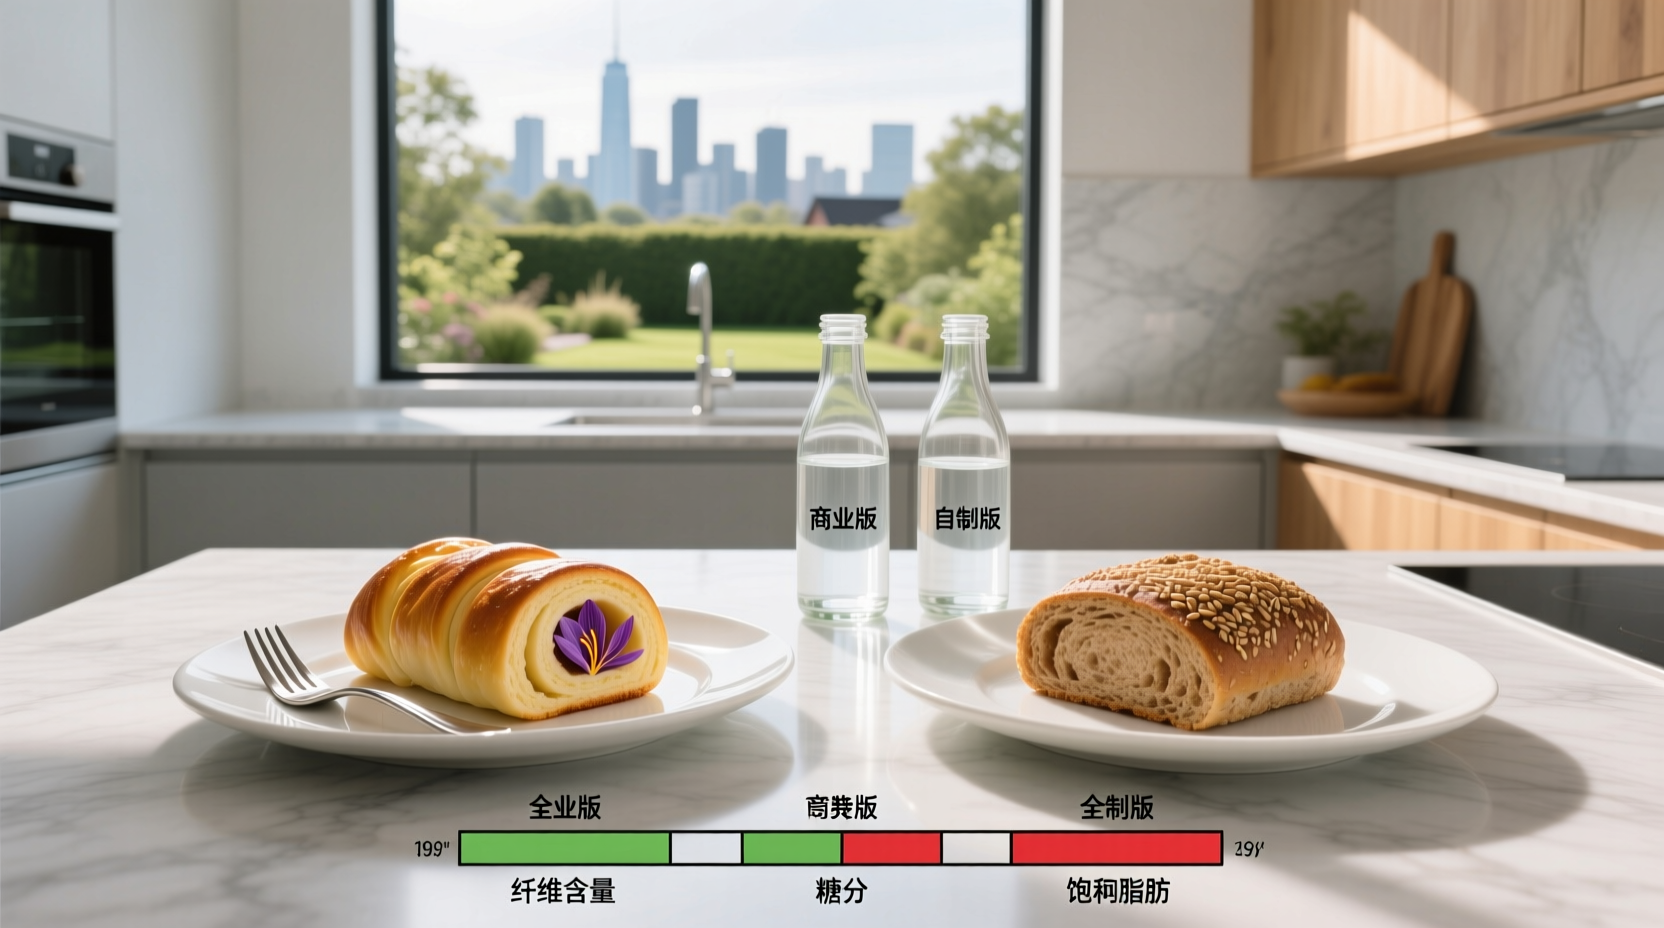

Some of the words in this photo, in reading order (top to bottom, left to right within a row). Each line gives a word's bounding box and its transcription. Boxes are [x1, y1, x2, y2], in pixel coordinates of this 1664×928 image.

[809, 505, 877, 531] 商业版
[935, 505, 1001, 531] 自制版
